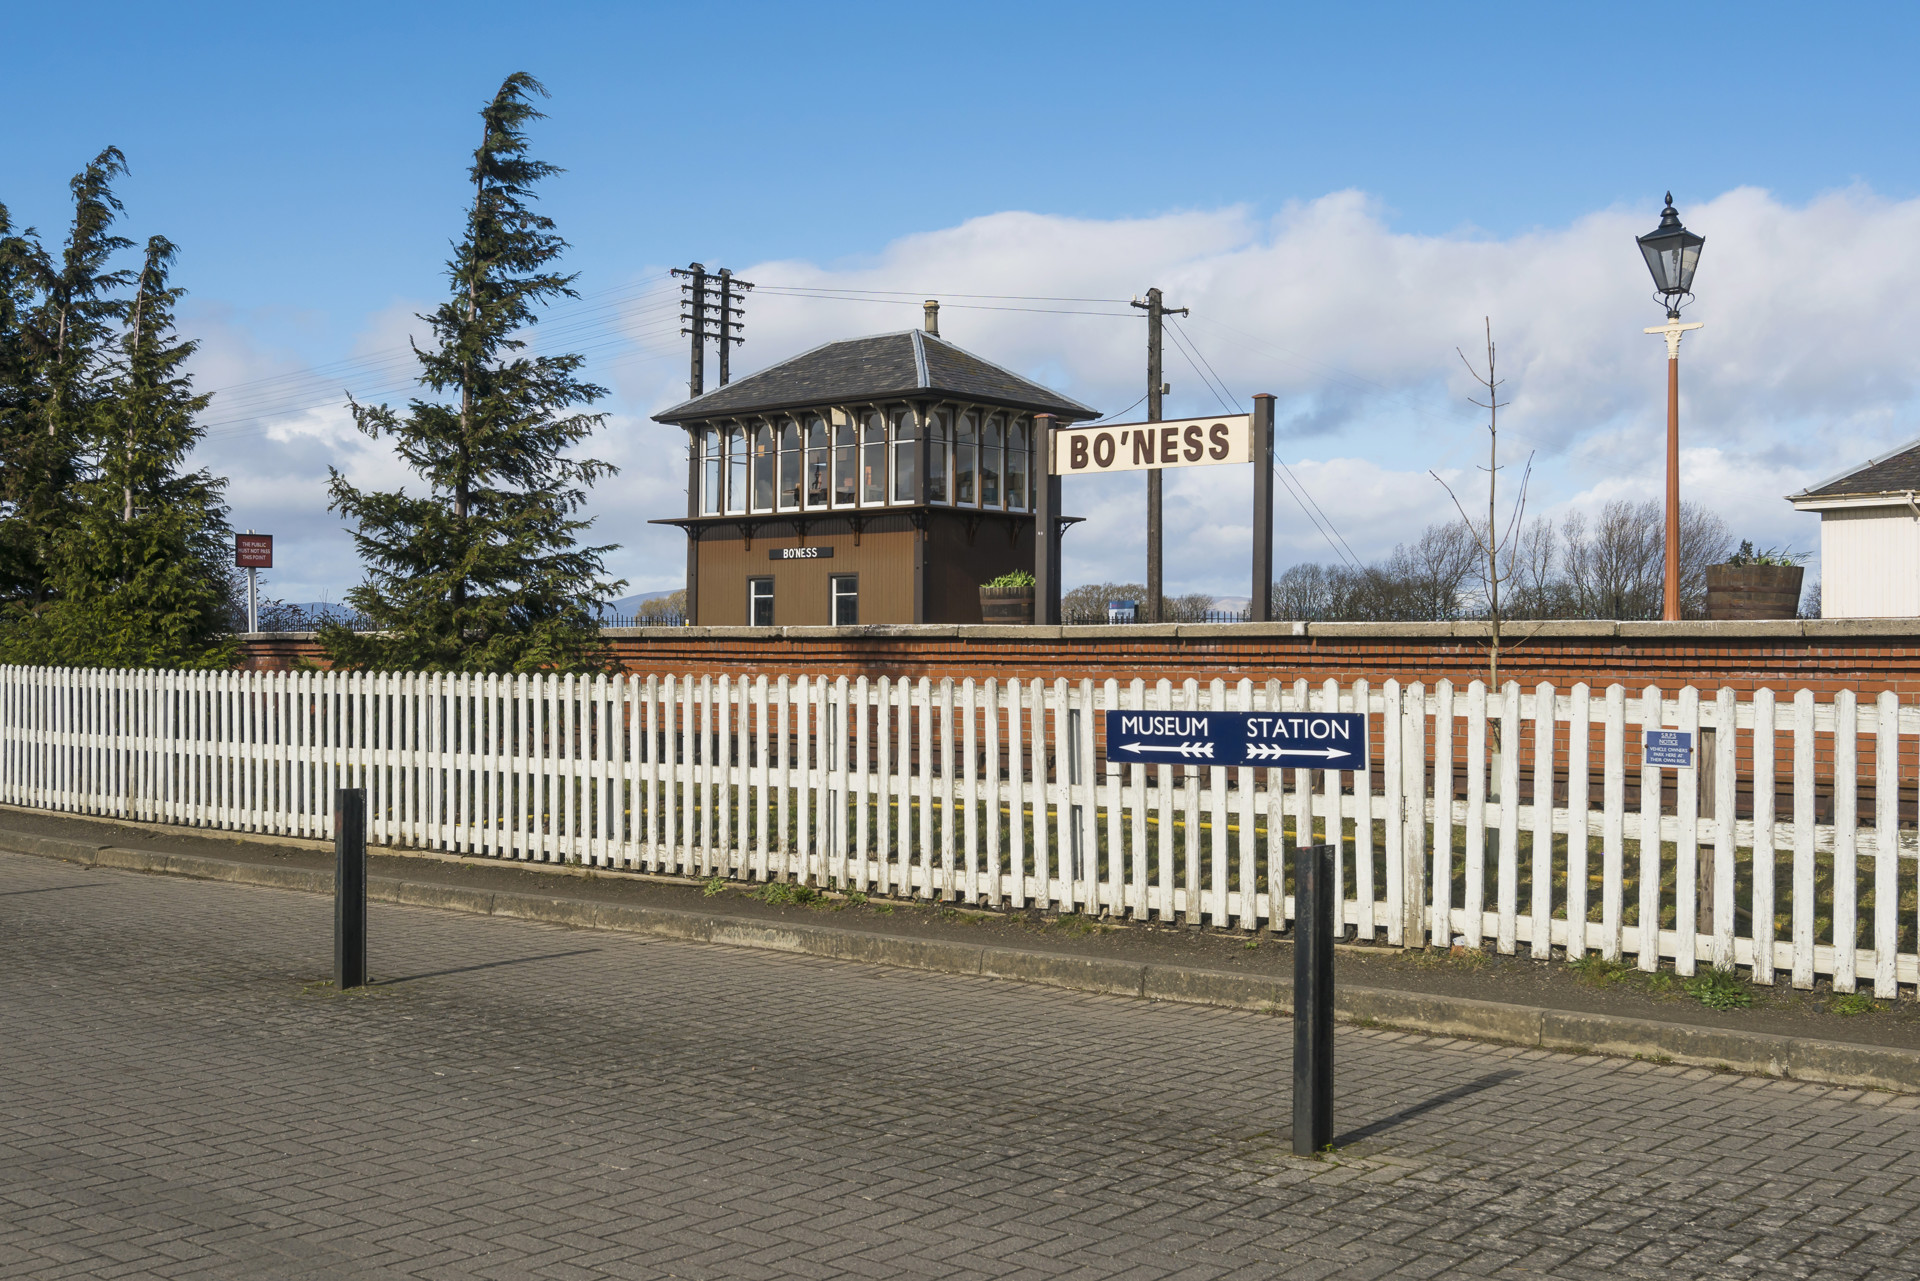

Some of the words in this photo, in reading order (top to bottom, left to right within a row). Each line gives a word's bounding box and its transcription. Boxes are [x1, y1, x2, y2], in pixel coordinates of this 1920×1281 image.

[1070, 423, 1230, 470] BO'NESS
[783, 547, 818, 558] BO'NESS
[1121, 716, 1209, 737] MUSEUM
[1246, 718, 1350, 740] STATION
